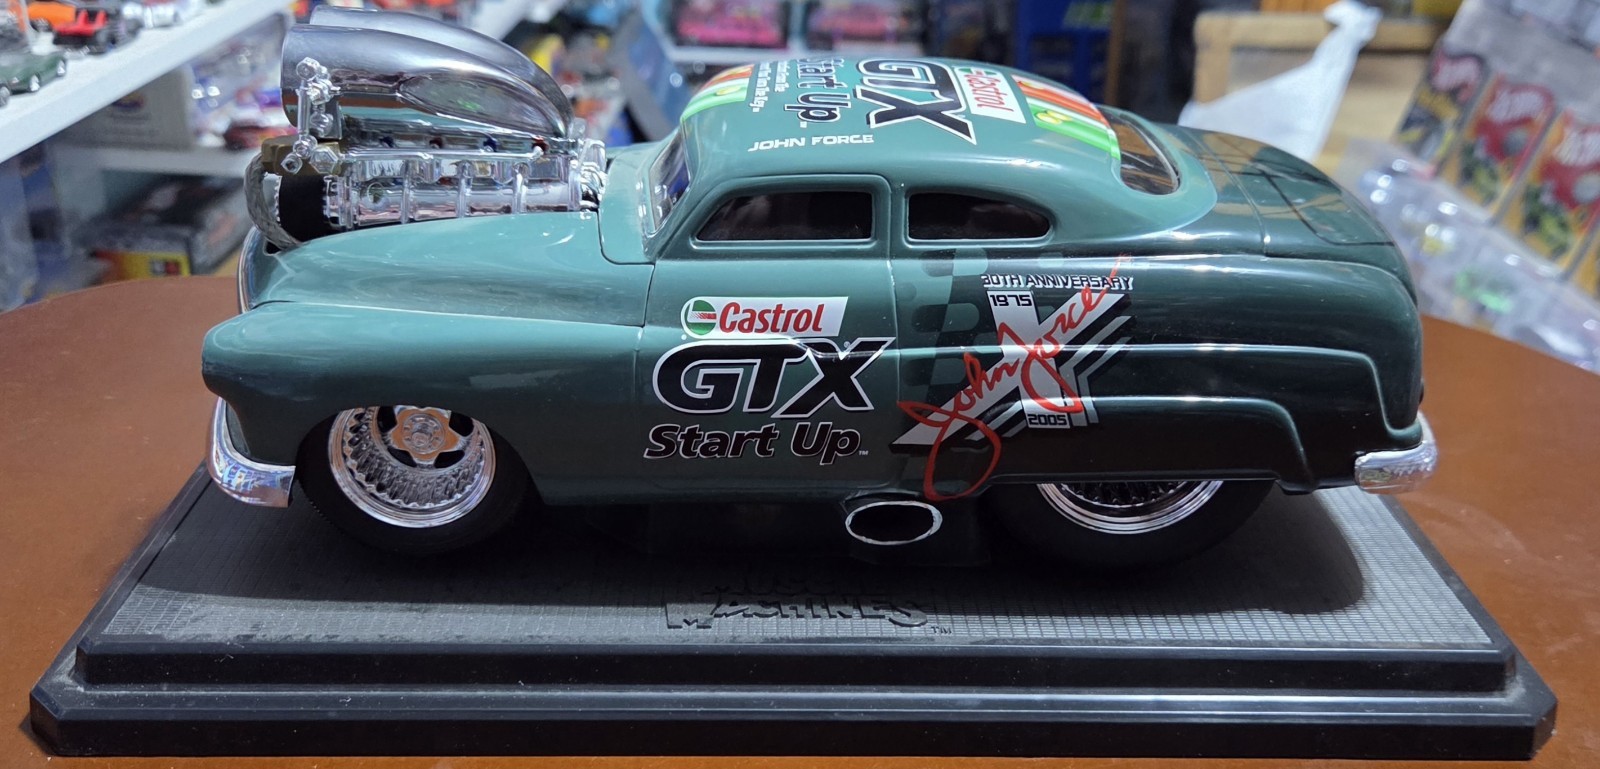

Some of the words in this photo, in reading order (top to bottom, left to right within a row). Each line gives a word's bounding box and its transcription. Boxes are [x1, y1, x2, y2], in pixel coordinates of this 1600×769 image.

[797, 58, 848, 88] Start
[784, 92, 851, 122] Up
[853, 57, 977, 145] GTX
[964, 74, 1014, 112] Castrol
[747, 137, 805, 152] JOHN
[811, 134, 874, 145] FORCE
[980, 274, 1022, 288] 30TH
[1025, 274, 1134, 290] ANNIVERSARY
[989, 294, 1032, 307] 1975
[719, 302, 825, 334] Castrol
[652, 337, 896, 418] GTX
[897, 350, 1020, 502] John
[1027, 413, 1068, 426] 2005
[643, 423, 781, 459] Start
[789, 421, 861, 466] Up
